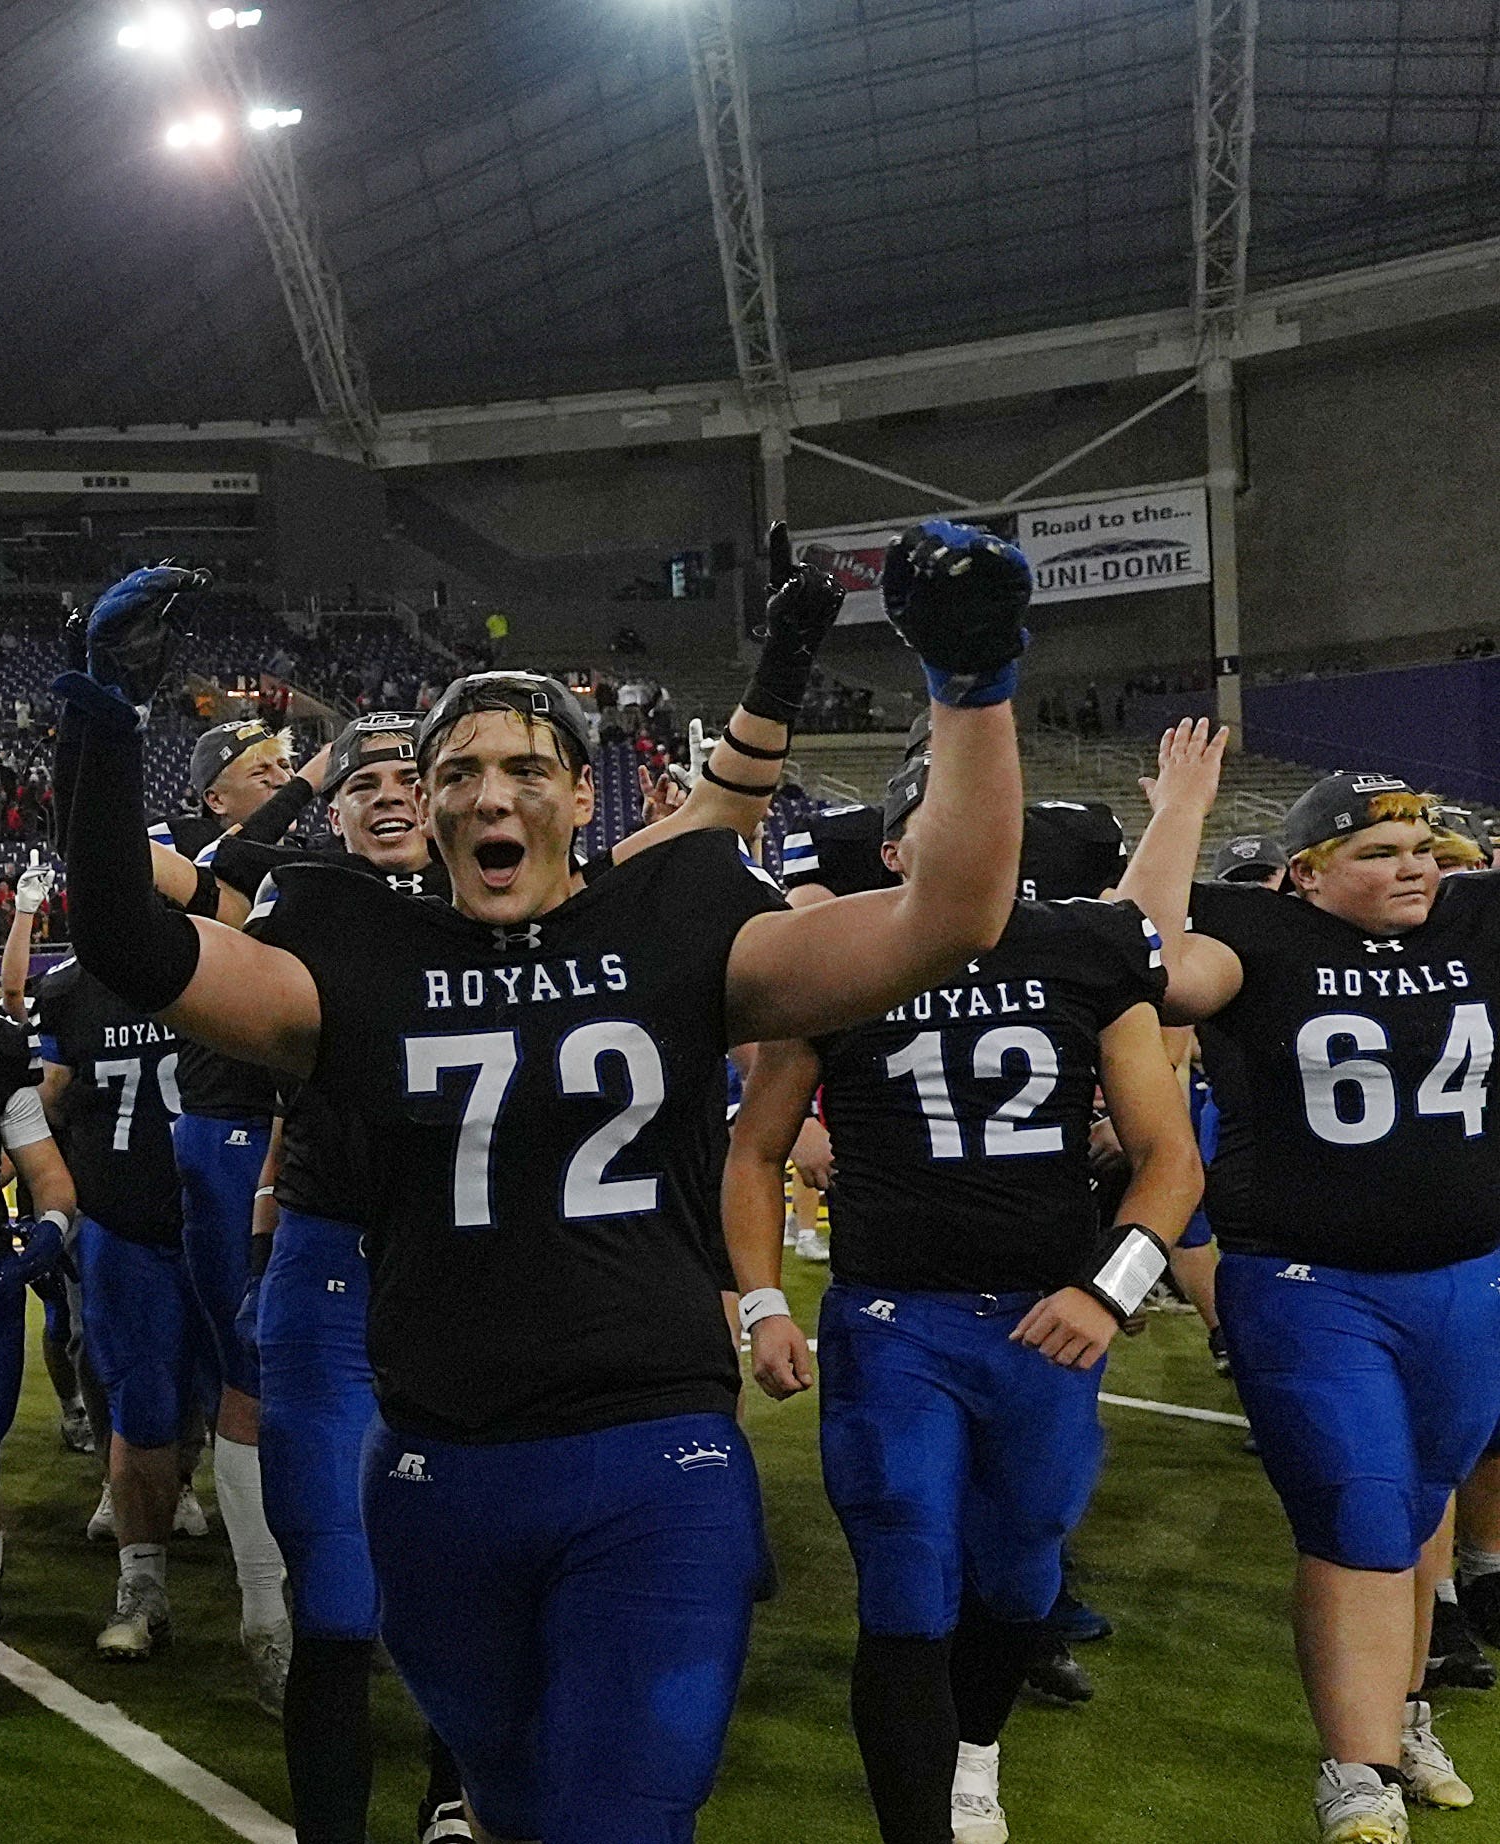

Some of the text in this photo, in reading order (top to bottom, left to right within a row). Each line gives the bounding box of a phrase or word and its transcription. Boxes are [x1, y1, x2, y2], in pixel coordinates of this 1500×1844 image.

[1031, 514, 1092, 538] Road
[1097, 511, 1126, 529] to
[1035, 548, 1193, 590] UNI-DOME
[425, 953, 629, 1010] ROYALS
[1317, 960, 1470, 996] ROYALS
[104, 1022, 176, 1048] ROYAL
[887, 1026, 1063, 1159] 12
[1296, 1003, 1493, 1145] 64
[404, 1020, 667, 1227] 72
